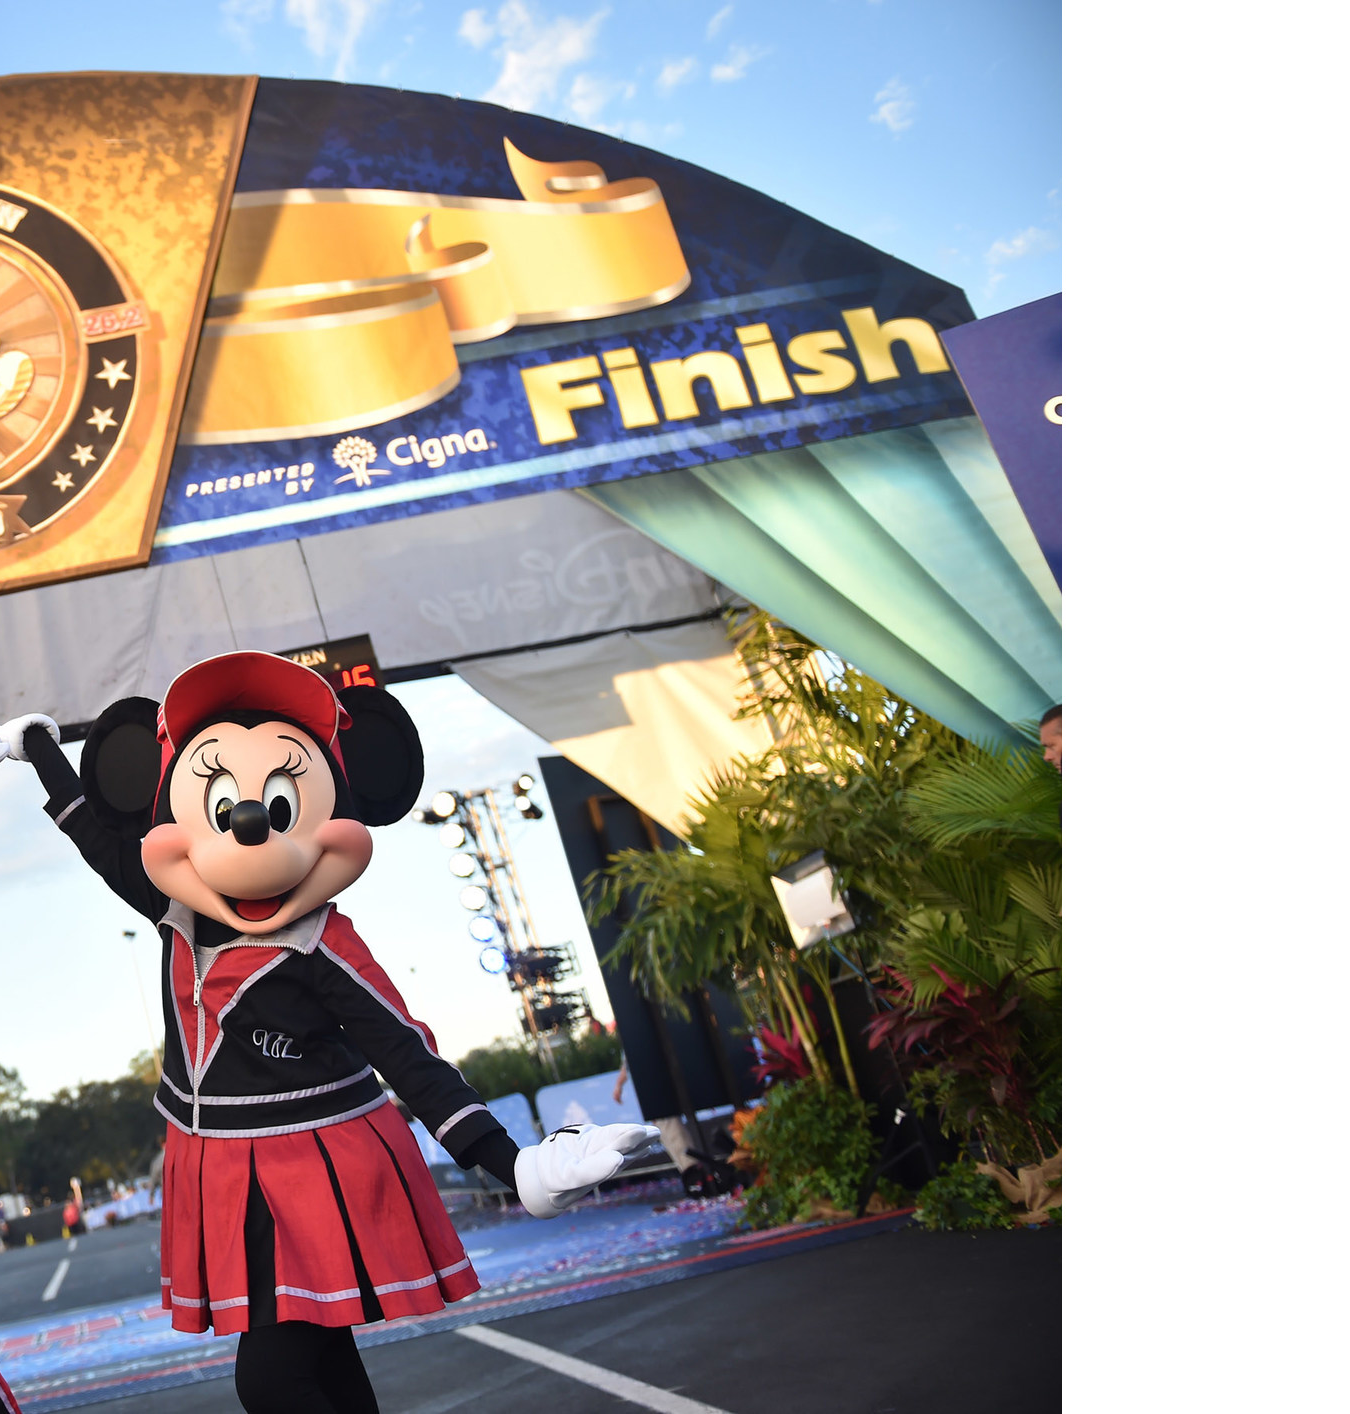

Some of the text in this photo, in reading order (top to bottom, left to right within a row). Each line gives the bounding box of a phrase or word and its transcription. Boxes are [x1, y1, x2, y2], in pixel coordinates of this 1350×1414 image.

[84, 307, 143, 335] 26.2
[520, 306, 950, 446] Finish
[185, 461, 316, 498] PRESENTED
[284, 477, 315, 497] BY
